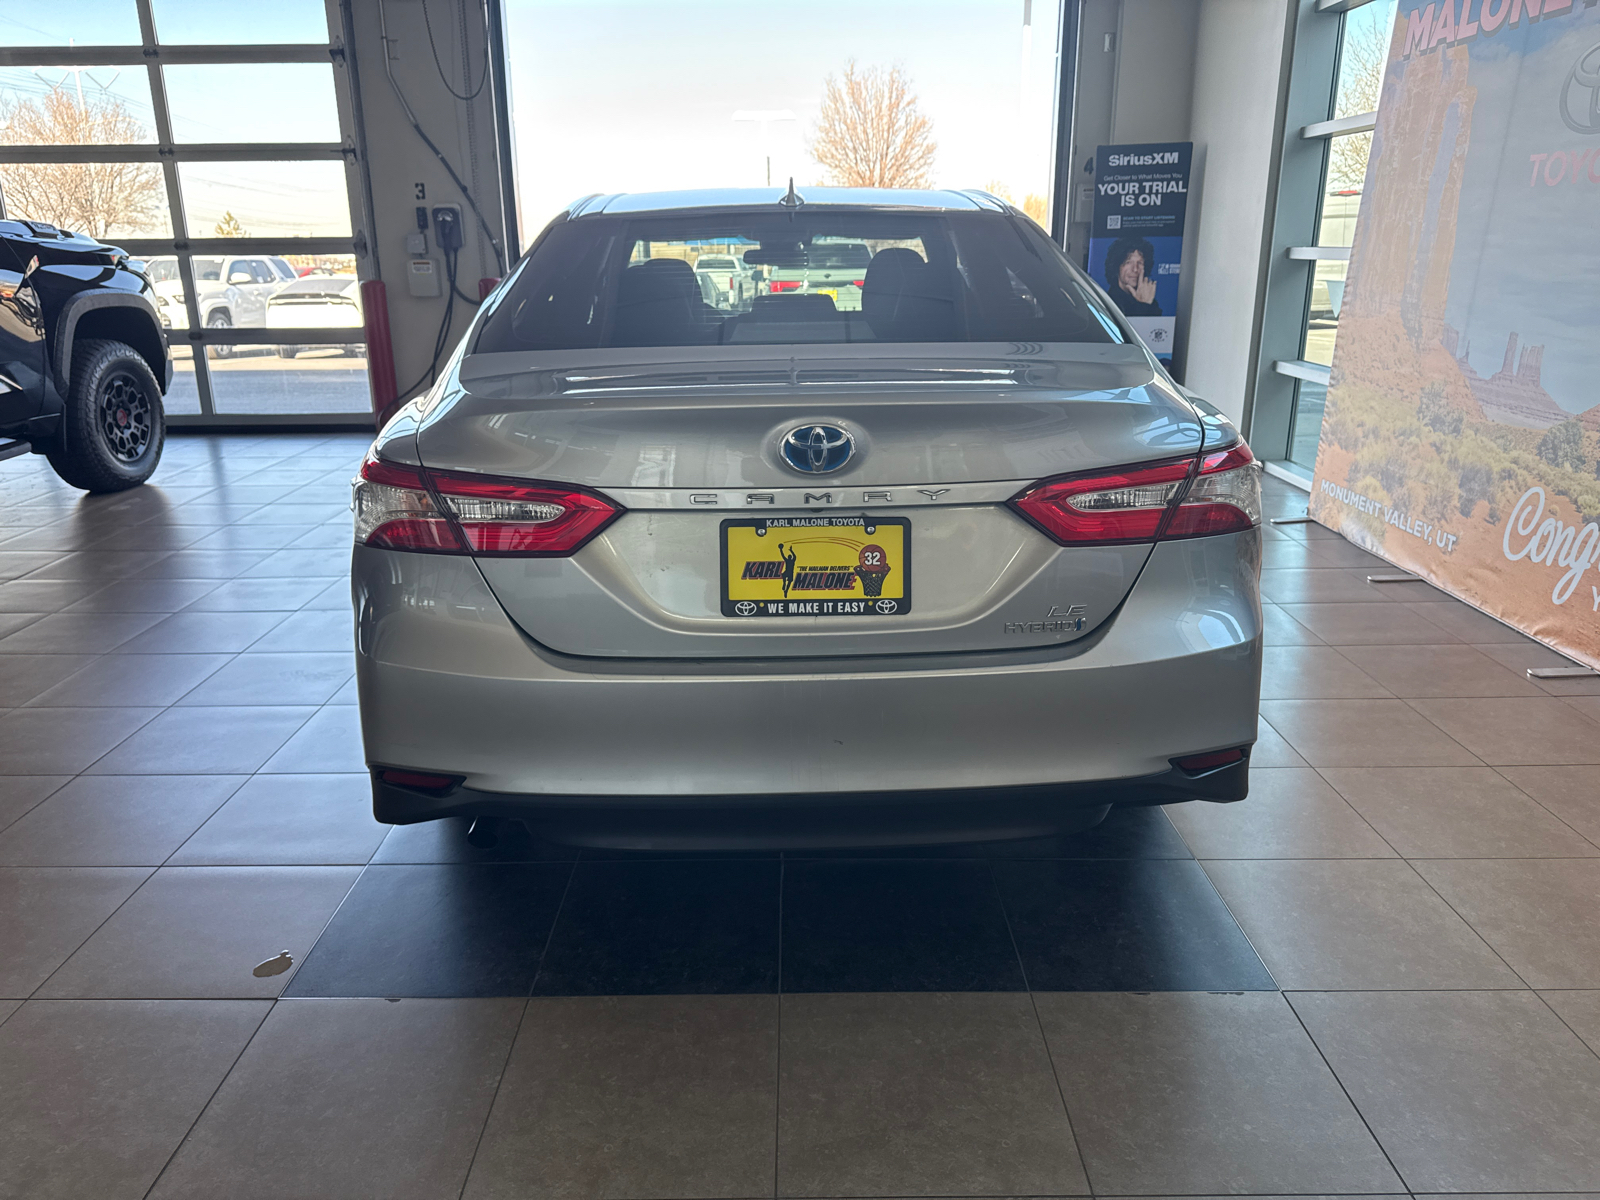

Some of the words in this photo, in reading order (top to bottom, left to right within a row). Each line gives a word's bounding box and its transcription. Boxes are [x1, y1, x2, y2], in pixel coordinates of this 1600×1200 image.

[1402, 0, 1572, 59] MALO
[1108, 152, 1179, 167] SiriusXM
[415, 183, 426, 200] 3
[1098, 182, 1140, 196] YOUR
[1142, 181, 1187, 194] TRIAL
[1120, 195, 1136, 207] IS
[1138, 194, 1162, 206] ON
[689, 488, 951, 505] CAMRY
[766, 519, 791, 527] KARL
[792, 519, 830, 527] MALONE
[831, 518, 865, 526] TOYOTA
[1321, 479, 1382, 518] MONUMENT
[1384, 506, 1433, 545] VALLEY,
[1436, 530, 1457, 552] UT
[864, 551, 881, 566] 32
[741, 561, 785, 580] KARL
[792, 571, 857, 591] MALONE
[767, 603, 784, 614] WE
[789, 602, 819, 613] MAKE
[823, 602, 833, 612] IT
[836, 602, 866, 613] EASY
[1047, 604, 1088, 617] LE
[1004, 621, 1076, 634] HYBRID
